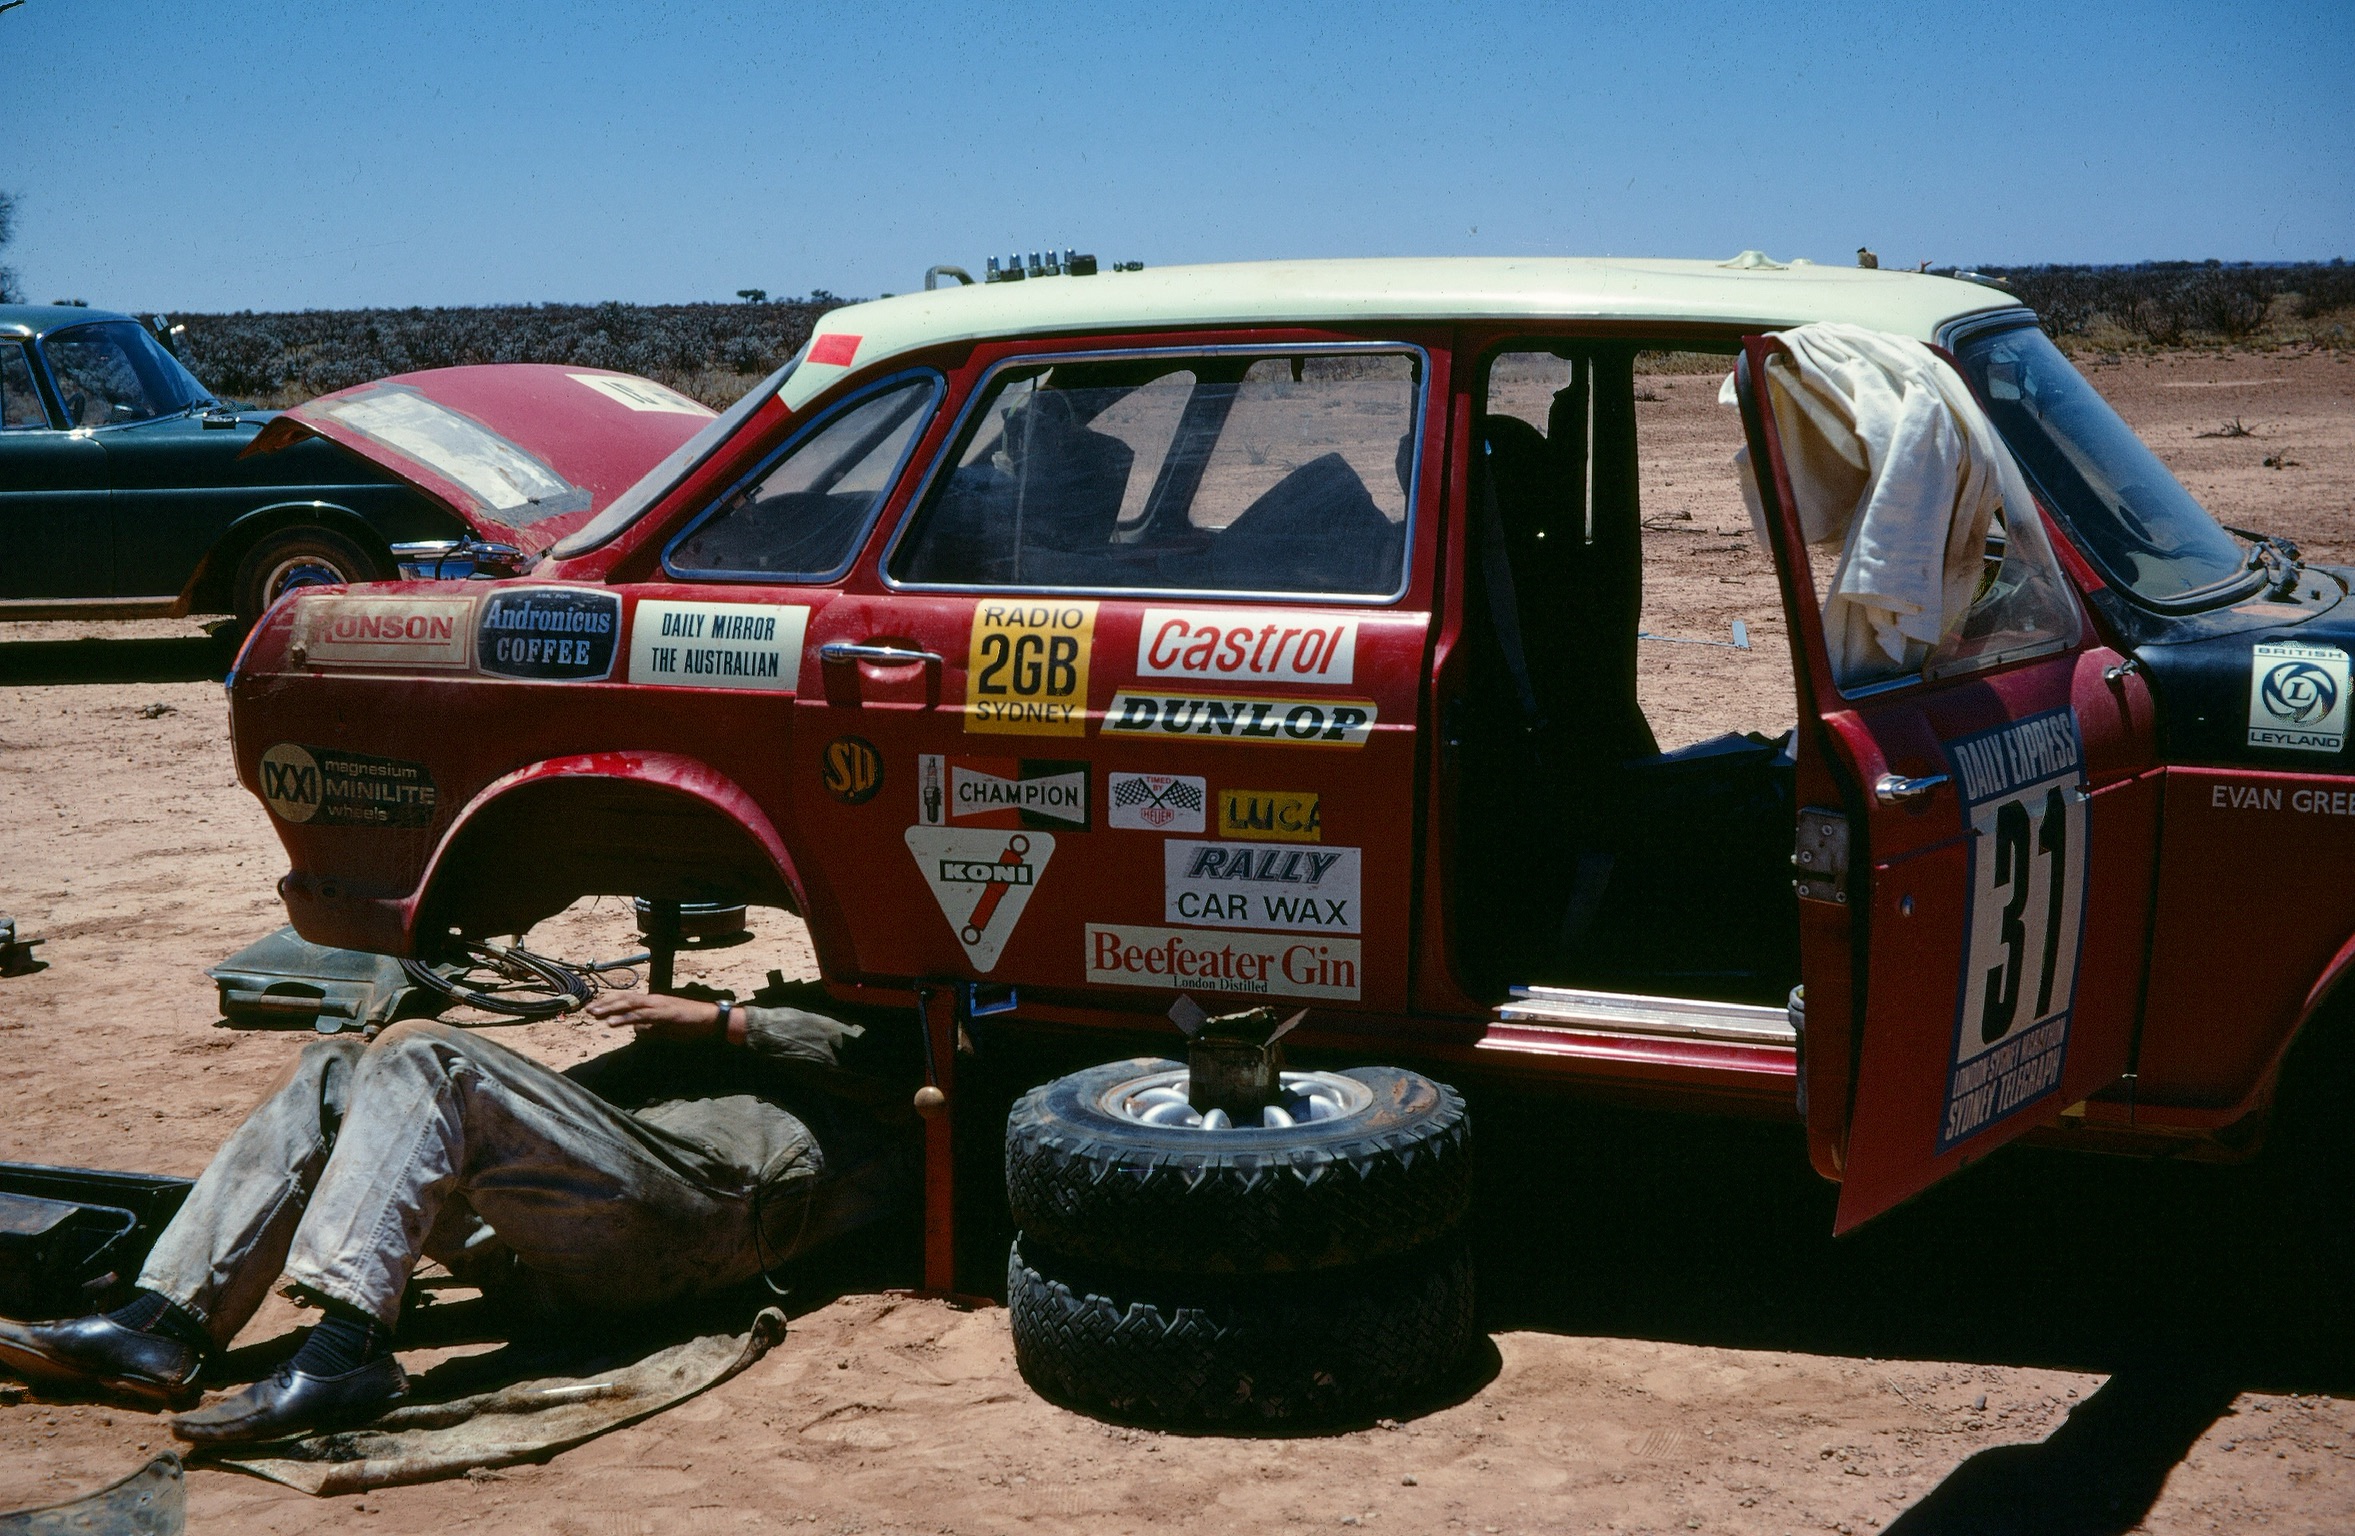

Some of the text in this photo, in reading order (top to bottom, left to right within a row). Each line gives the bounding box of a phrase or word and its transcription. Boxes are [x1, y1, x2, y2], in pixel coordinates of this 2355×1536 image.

[483, 600, 611, 633] Andronicus
[661, 612, 776, 641] DAILY MIRROR
[984, 606, 1084, 630] RADIO
[496, 637, 591, 665] COFFEE
[1147, 618, 1346, 675] Castrol
[2258, 646, 2343, 659] BRITISH
[651, 647, 779, 678] THE AUSTRALIAN
[978, 633, 1079, 697] 2GB
[975, 700, 1076, 723] SYDNEY
[1113, 697, 1368, 741] DUNLOP
[2250, 731, 2341, 748] LEYLAND
[324, 759, 418, 779] magnesium
[1954, 712, 2078, 800] DAILY EXPRESS
[326, 778, 436, 805] MINILITE
[1146, 776, 1172, 785] TIMED
[1152, 784, 1164, 793] BY
[959, 782, 1079, 807] CHAMPION
[2212, 785, 2282, 811] EVAN
[327, 803, 389, 822] wheels
[1142, 809, 1173, 824] HEUER
[944, 863, 1029, 883] KONI
[1188, 847, 1342, 885] RALLY
[1177, 892, 1349, 926] CAR WAX
[1981, 784, 2066, 1046] 31
[1091, 931, 1356, 988] Beefeater Gin
[1173, 976, 1268, 993] London Distilled
